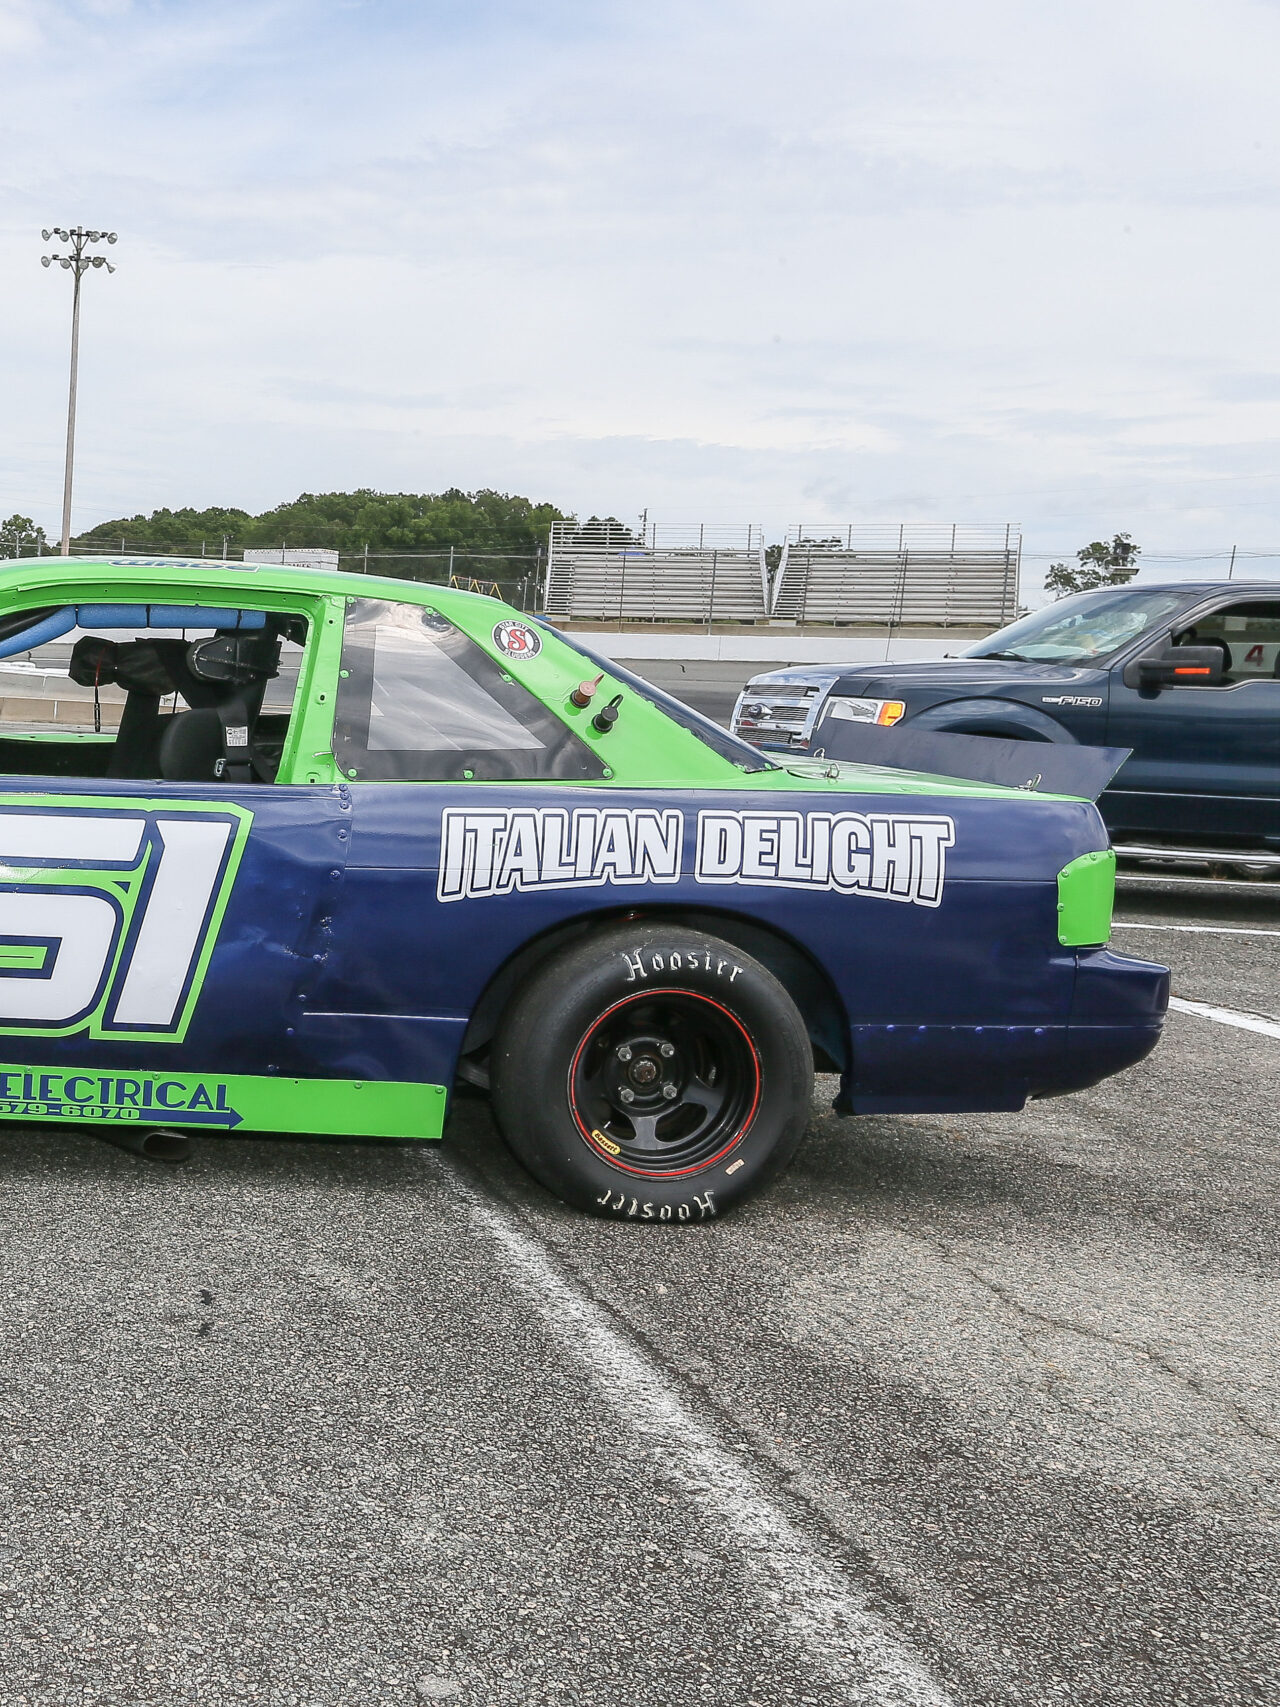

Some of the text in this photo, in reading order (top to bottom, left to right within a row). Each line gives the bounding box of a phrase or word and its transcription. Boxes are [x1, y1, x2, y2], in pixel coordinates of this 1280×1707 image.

[1244, 644, 1265, 668] 4
[437, 807, 956, 908] ITALIAN DELIGHT
[621, 948, 745, 983] Hoosier
